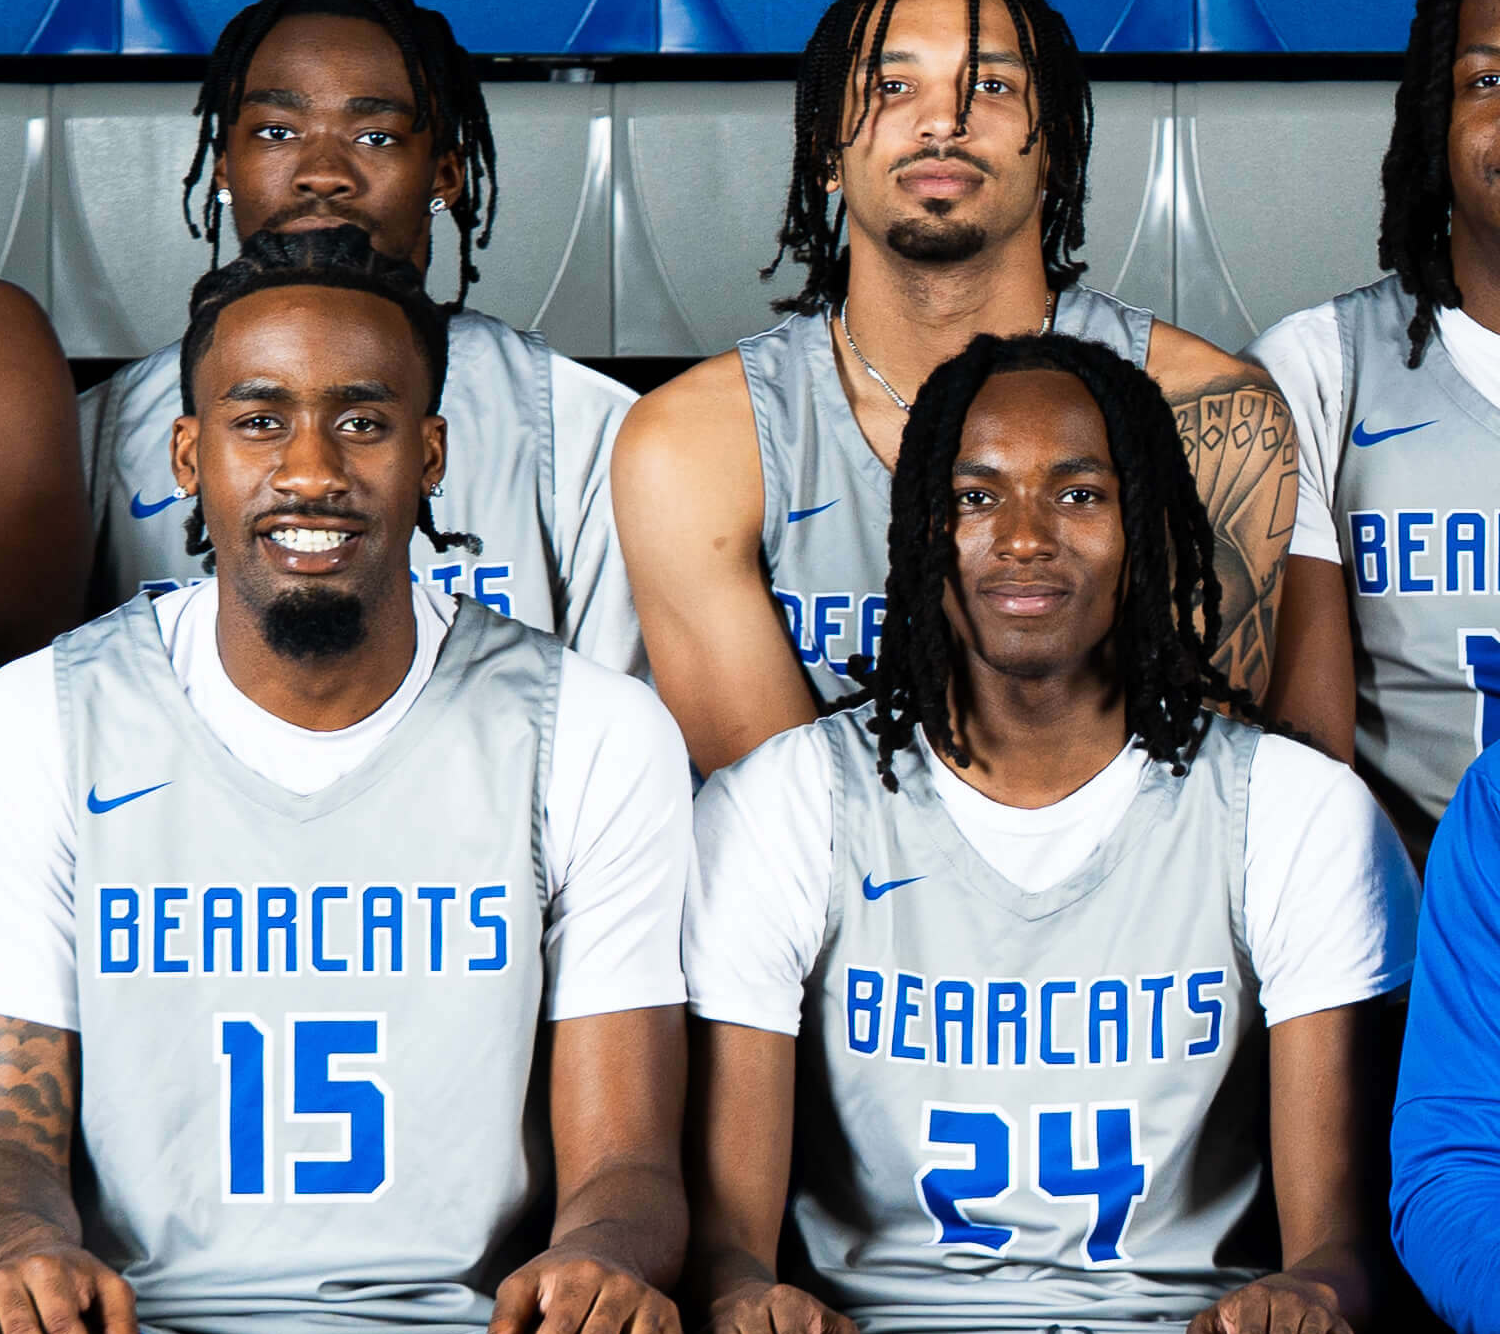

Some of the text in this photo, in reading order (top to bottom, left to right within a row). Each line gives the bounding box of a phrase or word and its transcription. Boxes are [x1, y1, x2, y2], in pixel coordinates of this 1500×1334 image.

[93, 882, 514, 979] BEARCATS
[842, 963, 1229, 1069] BEARCATS
[212, 1011, 394, 1205] 15
[914, 1098, 1153, 1269] 24
